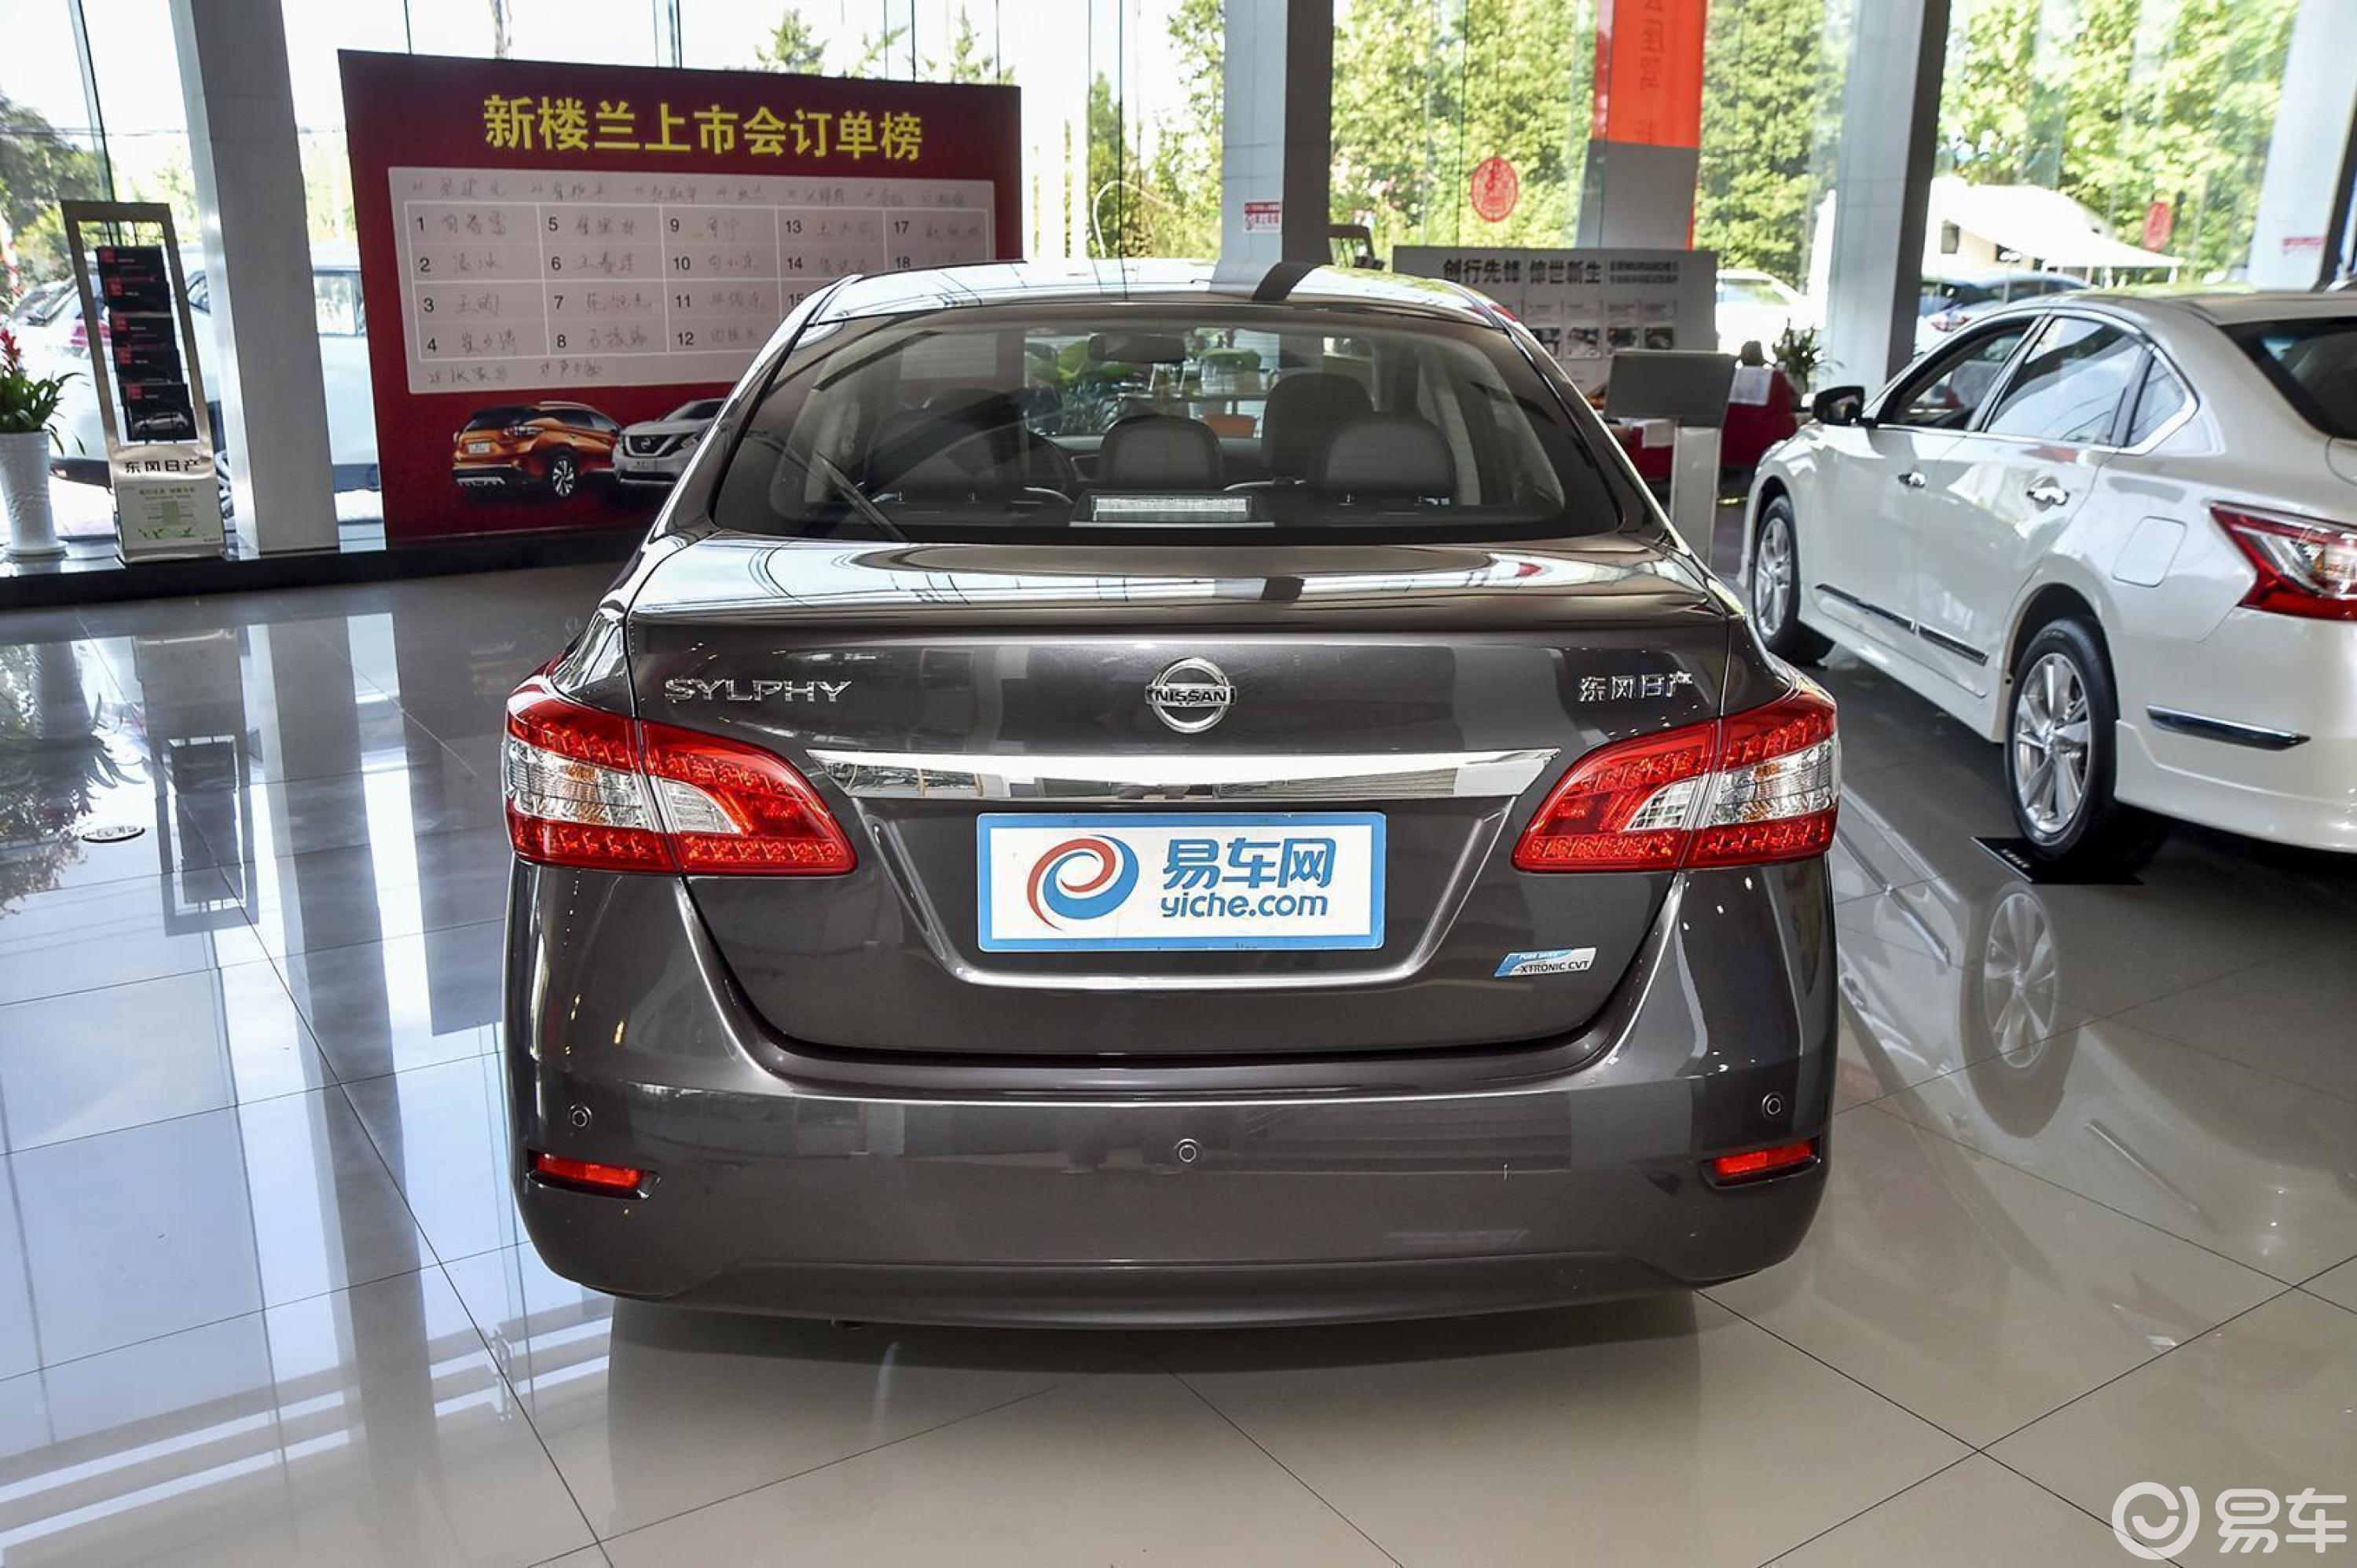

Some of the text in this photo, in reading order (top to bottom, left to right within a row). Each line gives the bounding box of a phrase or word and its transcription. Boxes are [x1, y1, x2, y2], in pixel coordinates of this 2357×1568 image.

[483, 94, 923, 160] 新楼兰上市会订单榜
[416, 217, 425, 231] 1
[548, 217, 559, 232] 5
[669, 218, 680, 233] 9
[786, 220, 802, 233] 13
[894, 221, 909, 233] 17
[419, 258, 431, 273] 2
[552, 257, 562, 271] 6
[674, 257, 691, 270] 10
[787, 257, 803, 270] 14
[896, 256, 911, 269] 18
[423, 298, 434, 313] 3
[554, 295, 563, 310] 7
[676, 295, 691, 308] 11
[427, 338, 437, 352] 4
[556, 335, 567, 348] 8
[678, 332, 695, 346] 12
[124, 458, 200, 474] 东风日产
[665, 678, 853, 702] SYLPHY
[1579, 671, 1693, 702] 东风日产
[1155, 691, 1226, 702] NISSAN
[1162, 837, 1336, 890] 易车网
[1160, 892, 1329, 918] yiche.com
[1520, 960, 1590, 973] XTRONIC CVT
